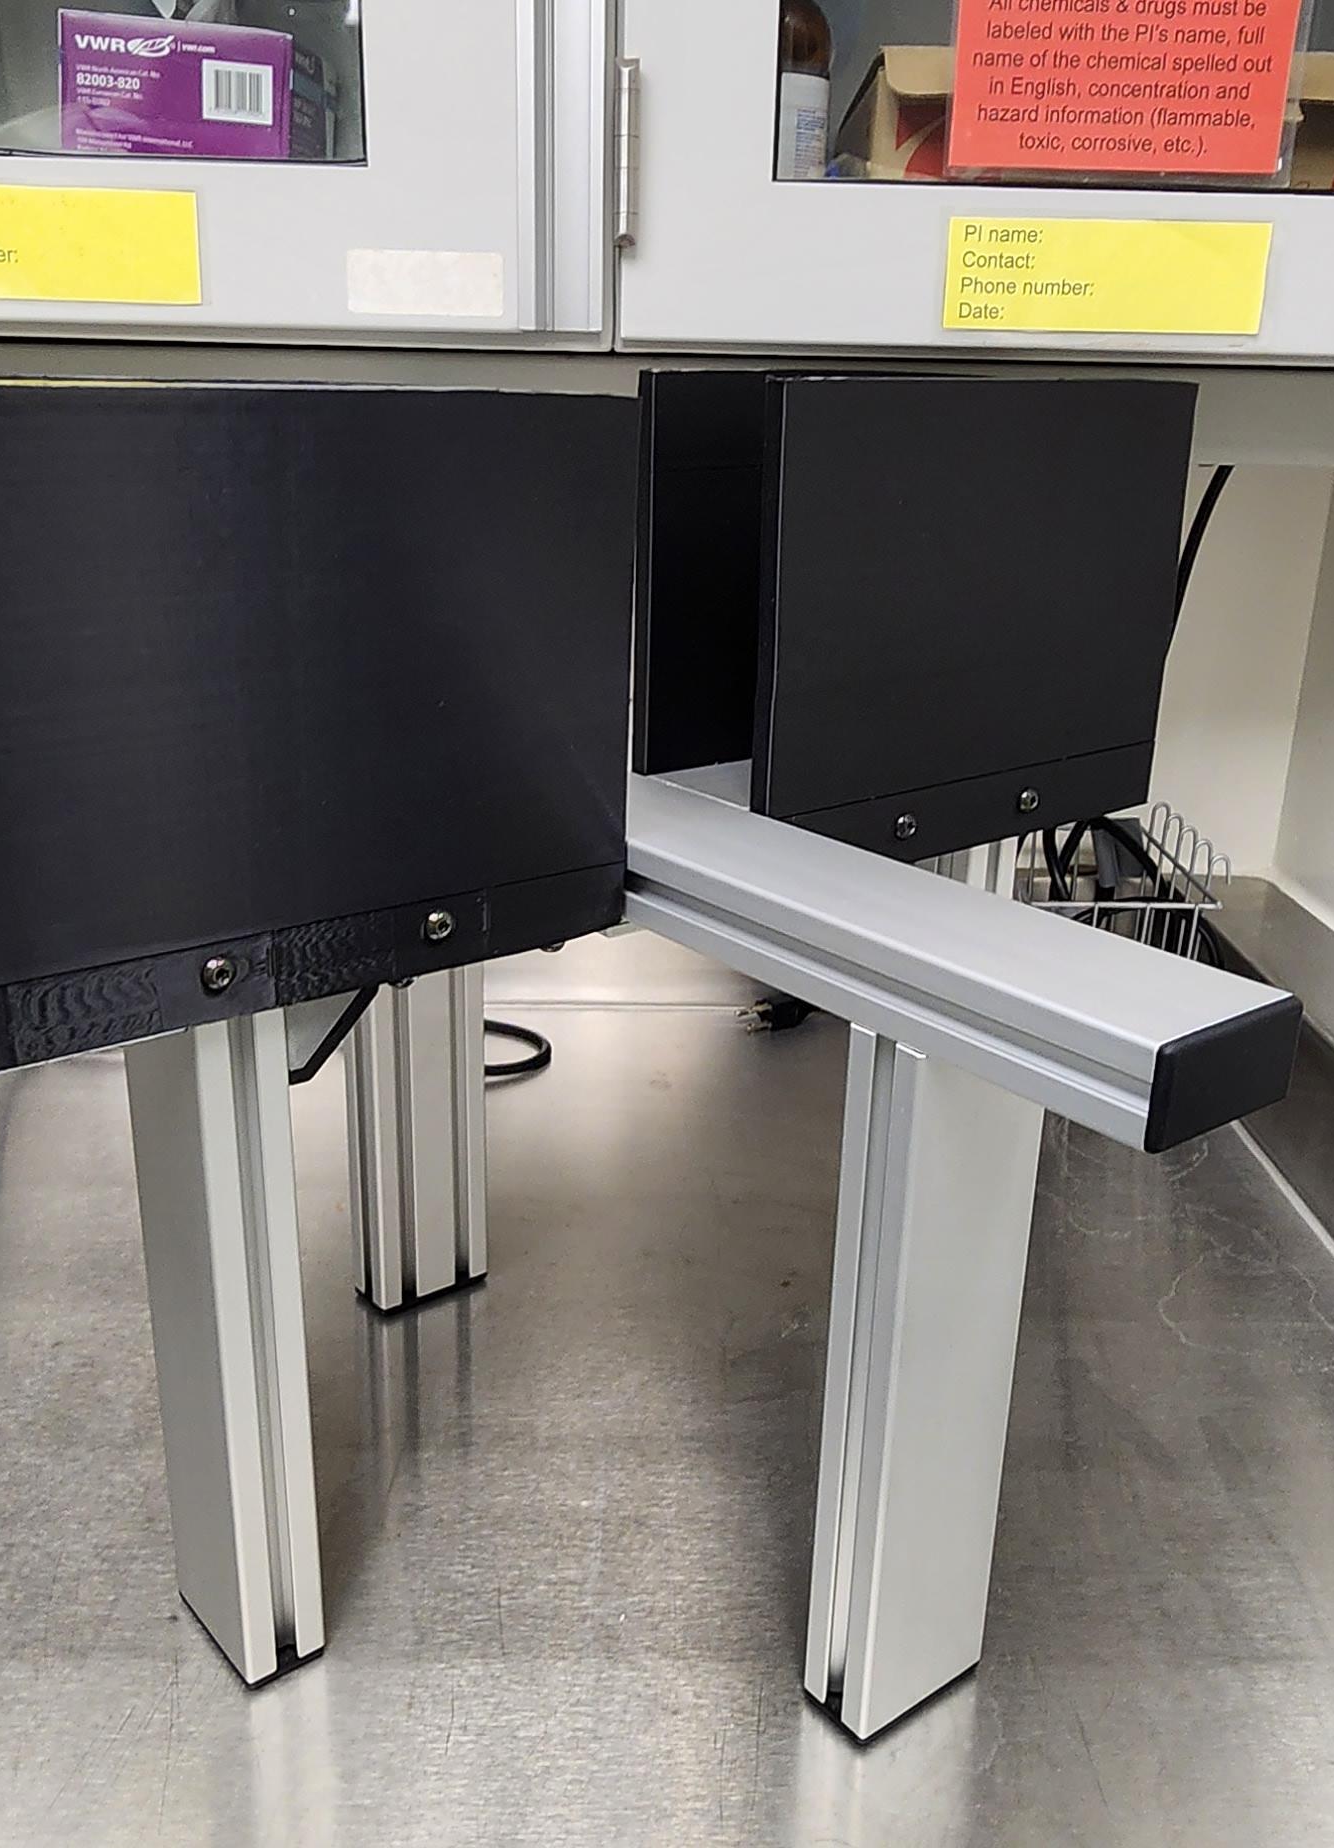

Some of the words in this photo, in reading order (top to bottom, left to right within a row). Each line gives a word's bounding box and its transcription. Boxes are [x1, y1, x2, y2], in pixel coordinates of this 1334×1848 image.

[987, 0, 1011, 10] All
[1018, 0, 1109, 12] chemicals
[1115, 0, 1128, 13] &
[1135, 0, 1187, 19] drugs
[1192, 0, 1237, 16] must
[1243, 0, 1267, 16] be
[74, 34, 126, 53] VWR
[987, 21, 1052, 40] labeled
[1059, 22, 1095, 41] with
[1101, 24, 1129, 42] the
[1134, 24, 1168, 43] PI's
[1174, 28, 1230, 47] name,
[1237, 25, 1266, 45] full
[973, 52, 1024, 68] name
[1030, 50, 1048, 69] of
[1053, 51, 1081, 69] the
[1087, 52, 1167, 71] chemical
[1172, 53, 1238, 75] spelled
[1243, 56, 1273, 73] out
[76, 72, 141, 90] 82003-820
[988, 77, 1005, 95] in
[1010, 77, 1082, 99] English,
[1088, 79, 1210, 100] concentration
[1216, 82, 1251, 101] and
[977, 104, 1039, 123] hazard
[1044, 105, 1144, 126] information
[1149, 107, 1256, 130] (flammable,
[1018, 132, 1065, 152] toxic,
[1071, 134, 1158, 155] corrosive,
[1163, 136, 1208, 157] etc.).
[964, 225, 983, 242] PI
[988, 227, 1044, 243] name:
[962, 251, 1036, 269] Contact:
[960, 276, 1017, 295] Phone
[1022, 278, 1095, 296] number:
[958, 302, 1005, 320] Date:
